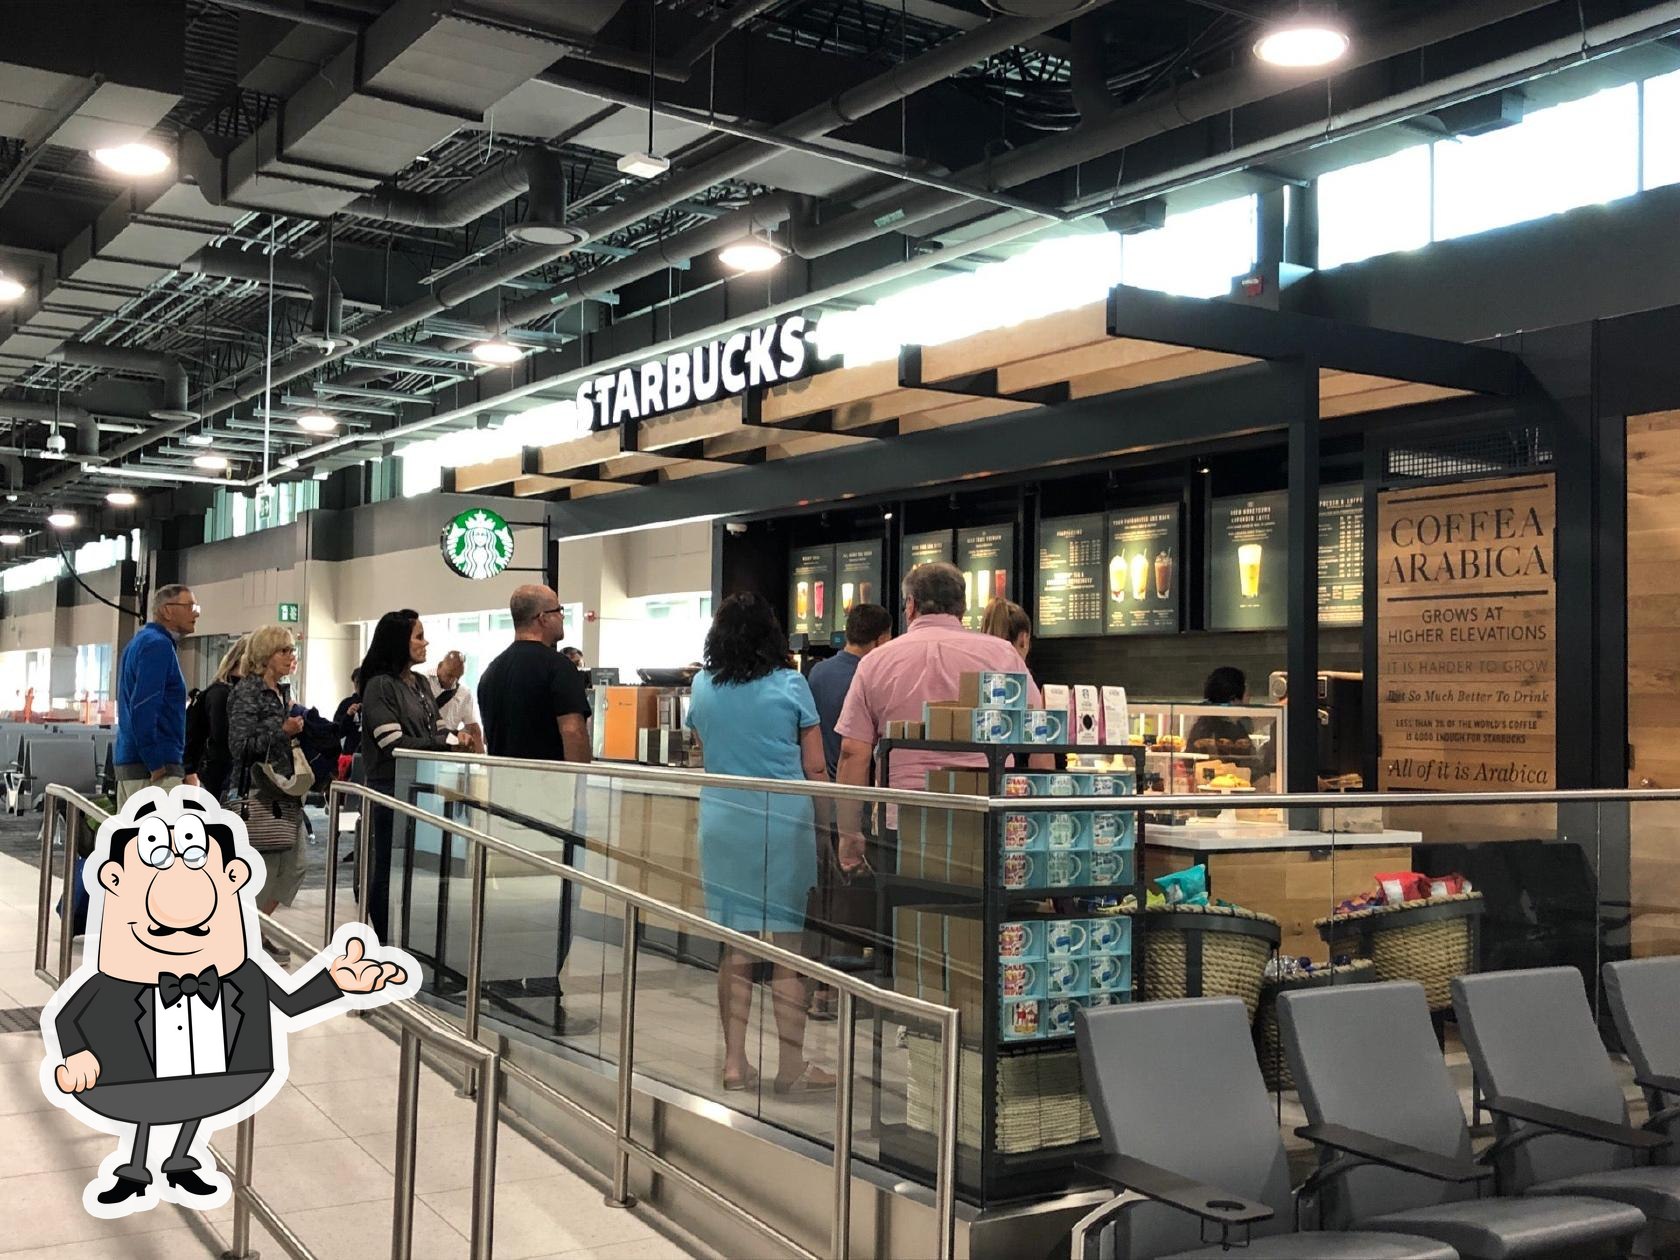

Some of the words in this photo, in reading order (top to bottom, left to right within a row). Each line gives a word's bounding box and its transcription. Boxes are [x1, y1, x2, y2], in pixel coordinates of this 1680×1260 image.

[576, 315, 805, 432] STARBUCKS
[1390, 506, 1544, 548] COFFEA
[1384, 544, 1549, 585] ARABICA
[1422, 606, 1478, 624] GROWS
[1485, 606, 1504, 621] AT
[1388, 628, 1444, 643] HIGHER
[1450, 625, 1547, 642] ELEVATIONS
[1387, 661, 1398, 674] IT
[1403, 661, 1414, 673] IS
[1419, 660, 1472, 674] HARDER
[1480, 660, 1498, 673] TO
[1502, 659, 1548, 673] GROW
[1409, 690, 1421, 703] So
[1425, 690, 1455, 702] Much
[1458, 690, 1493, 703] Better
[1497, 690, 1511, 703] To
[1514, 689, 1549, 703] Drink
[1459, 720, 1472, 729] THE
[1389, 759, 1413, 777] All
[1416, 759, 1436, 781] of
[1437, 760, 1450, 780] it
[1455, 761, 1470, 780] is
[1474, 761, 1548, 785] Arabica
